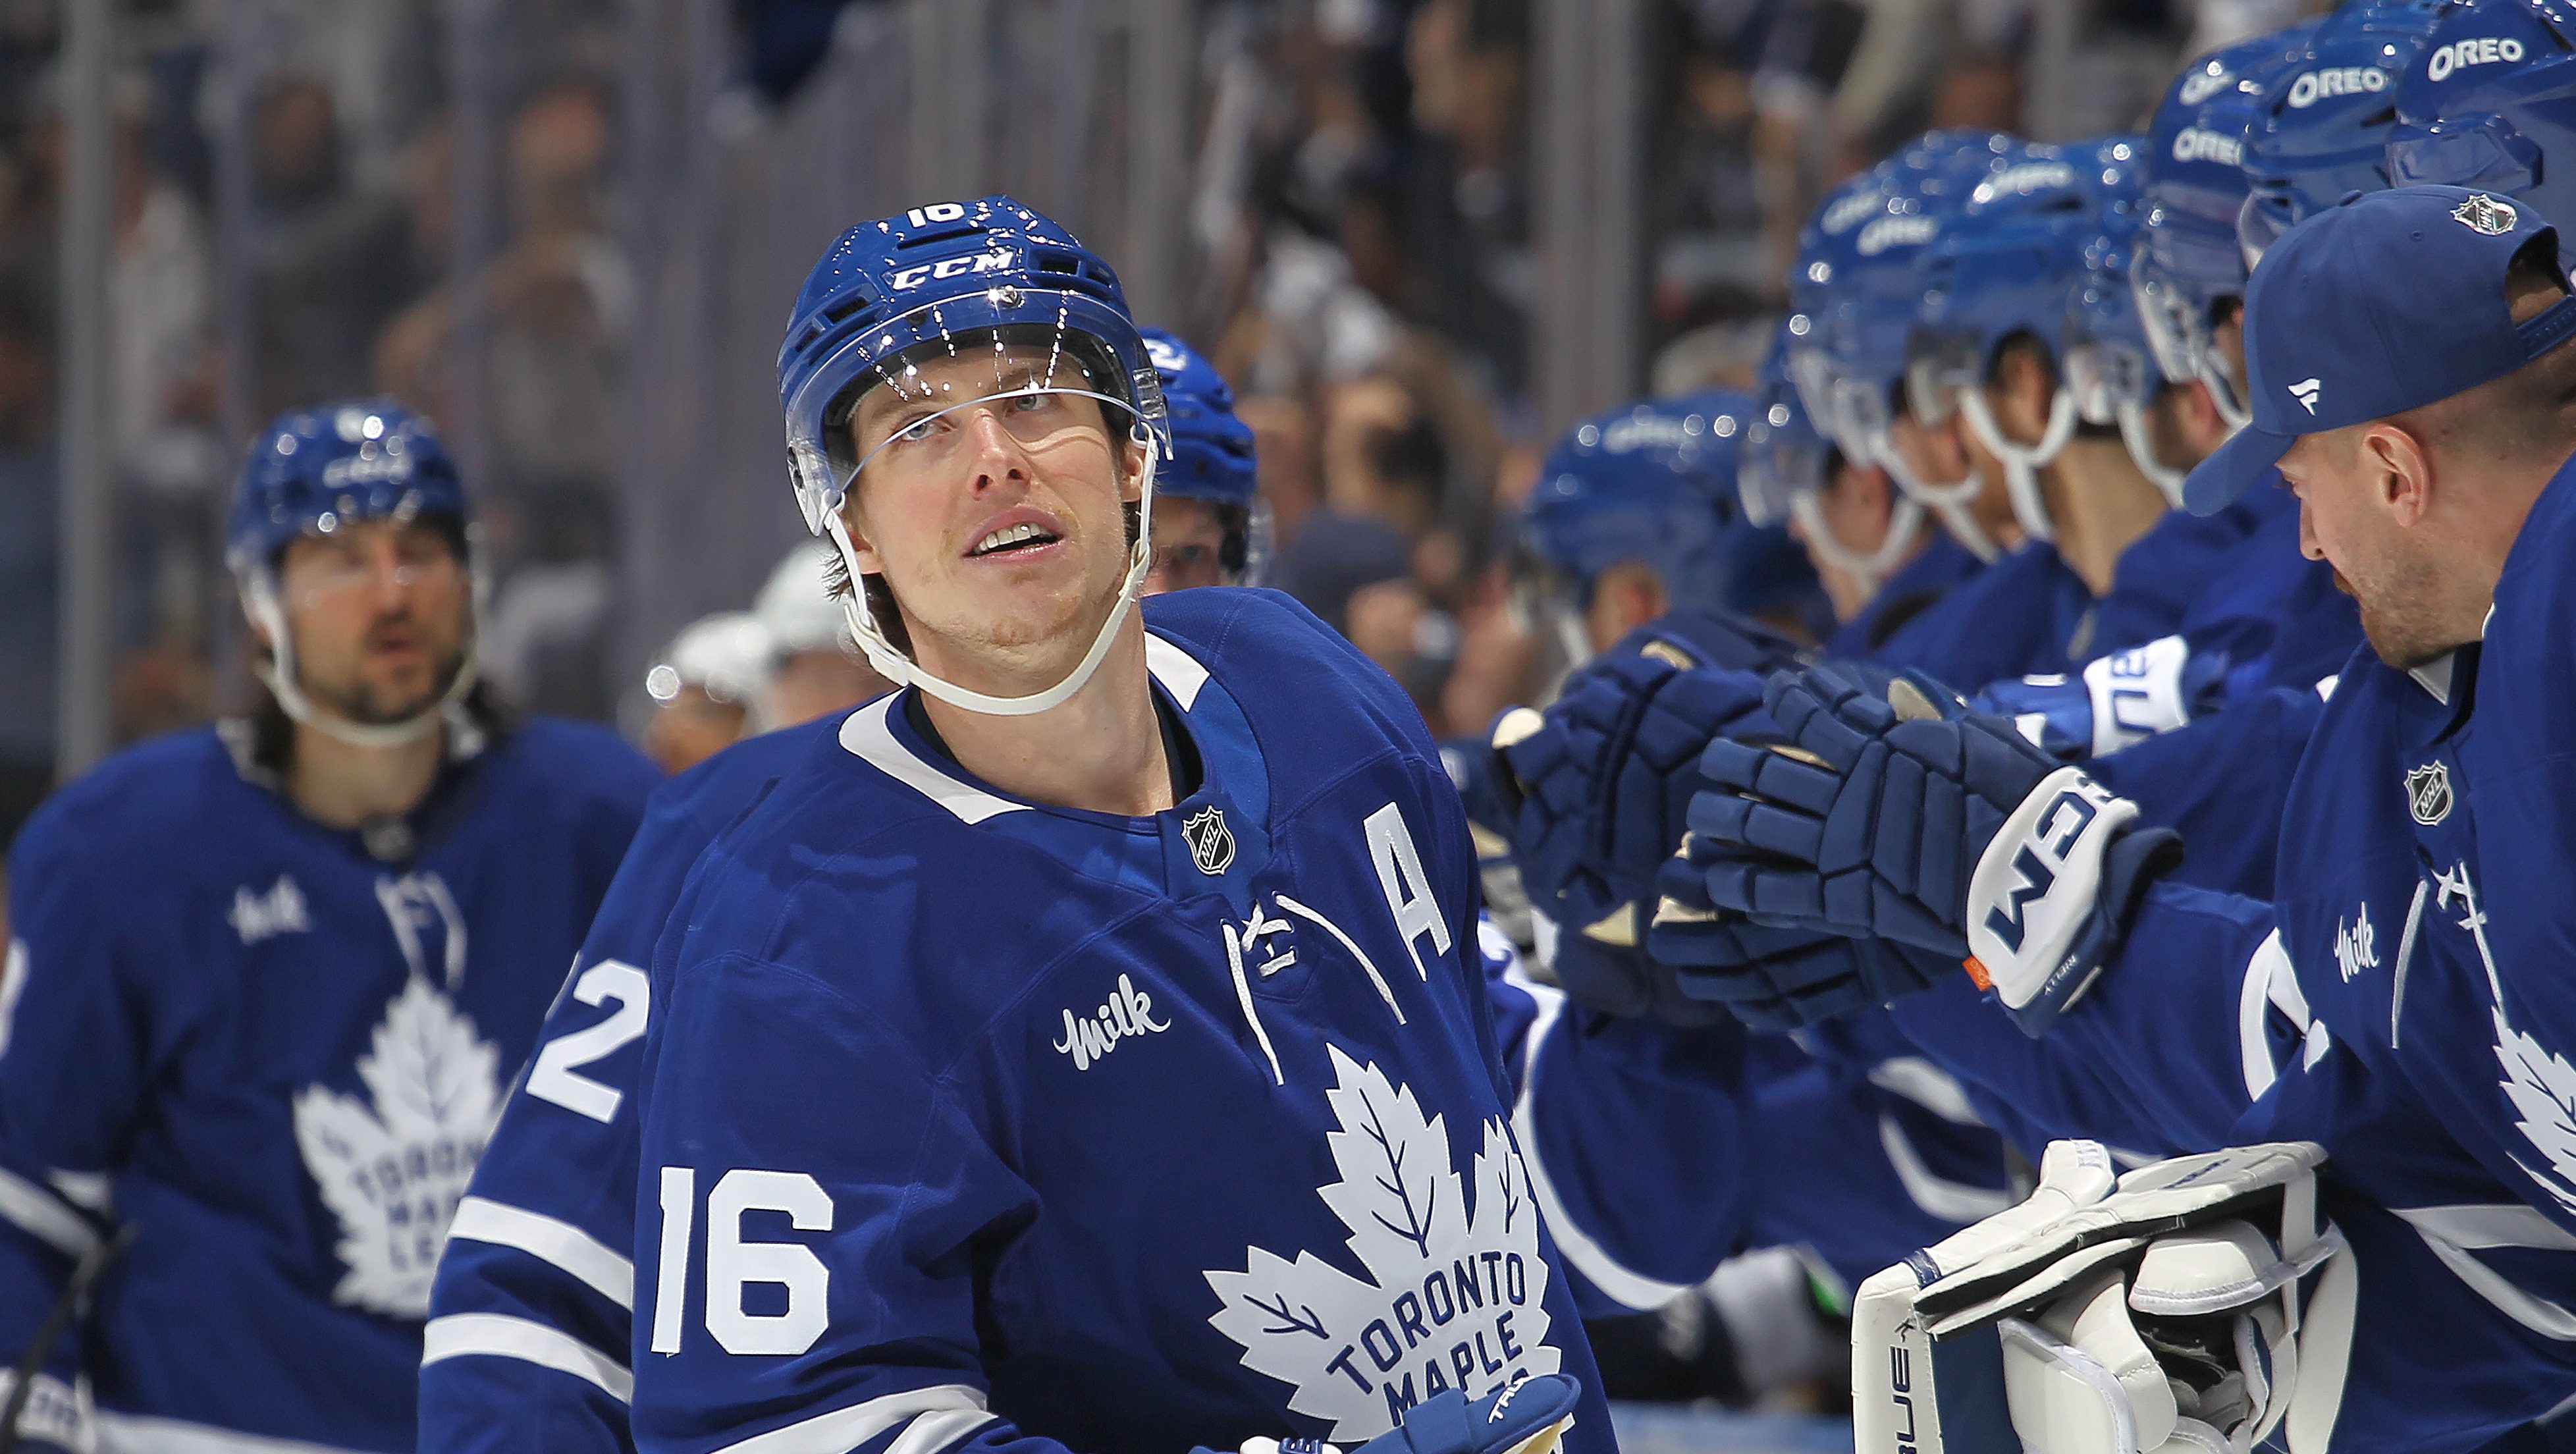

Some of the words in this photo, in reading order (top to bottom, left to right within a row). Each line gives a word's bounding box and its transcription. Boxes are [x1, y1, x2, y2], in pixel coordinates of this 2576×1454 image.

[2288, 67, 2386, 108] OREO
[2428, 37, 2525, 82] OREO
[892, 252, 1013, 290] CCM
[1201, 825, 1219, 865] NHL
[1363, 801, 1452, 982] A
[1984, 774, 2115, 955] CM
[2333, 901, 2380, 984] Milk
[525, 950, 651, 1124] 2
[1054, 973, 1171, 1071] Milk
[650, 1166, 834, 1357] 16
[1326, 1251, 1526, 1395] TORONTO
[1382, 1309, 1524, 1427] MAPLE
[1488, 1375, 1536, 1424] TRU
[1889, 1345, 1919, 1454] UE
